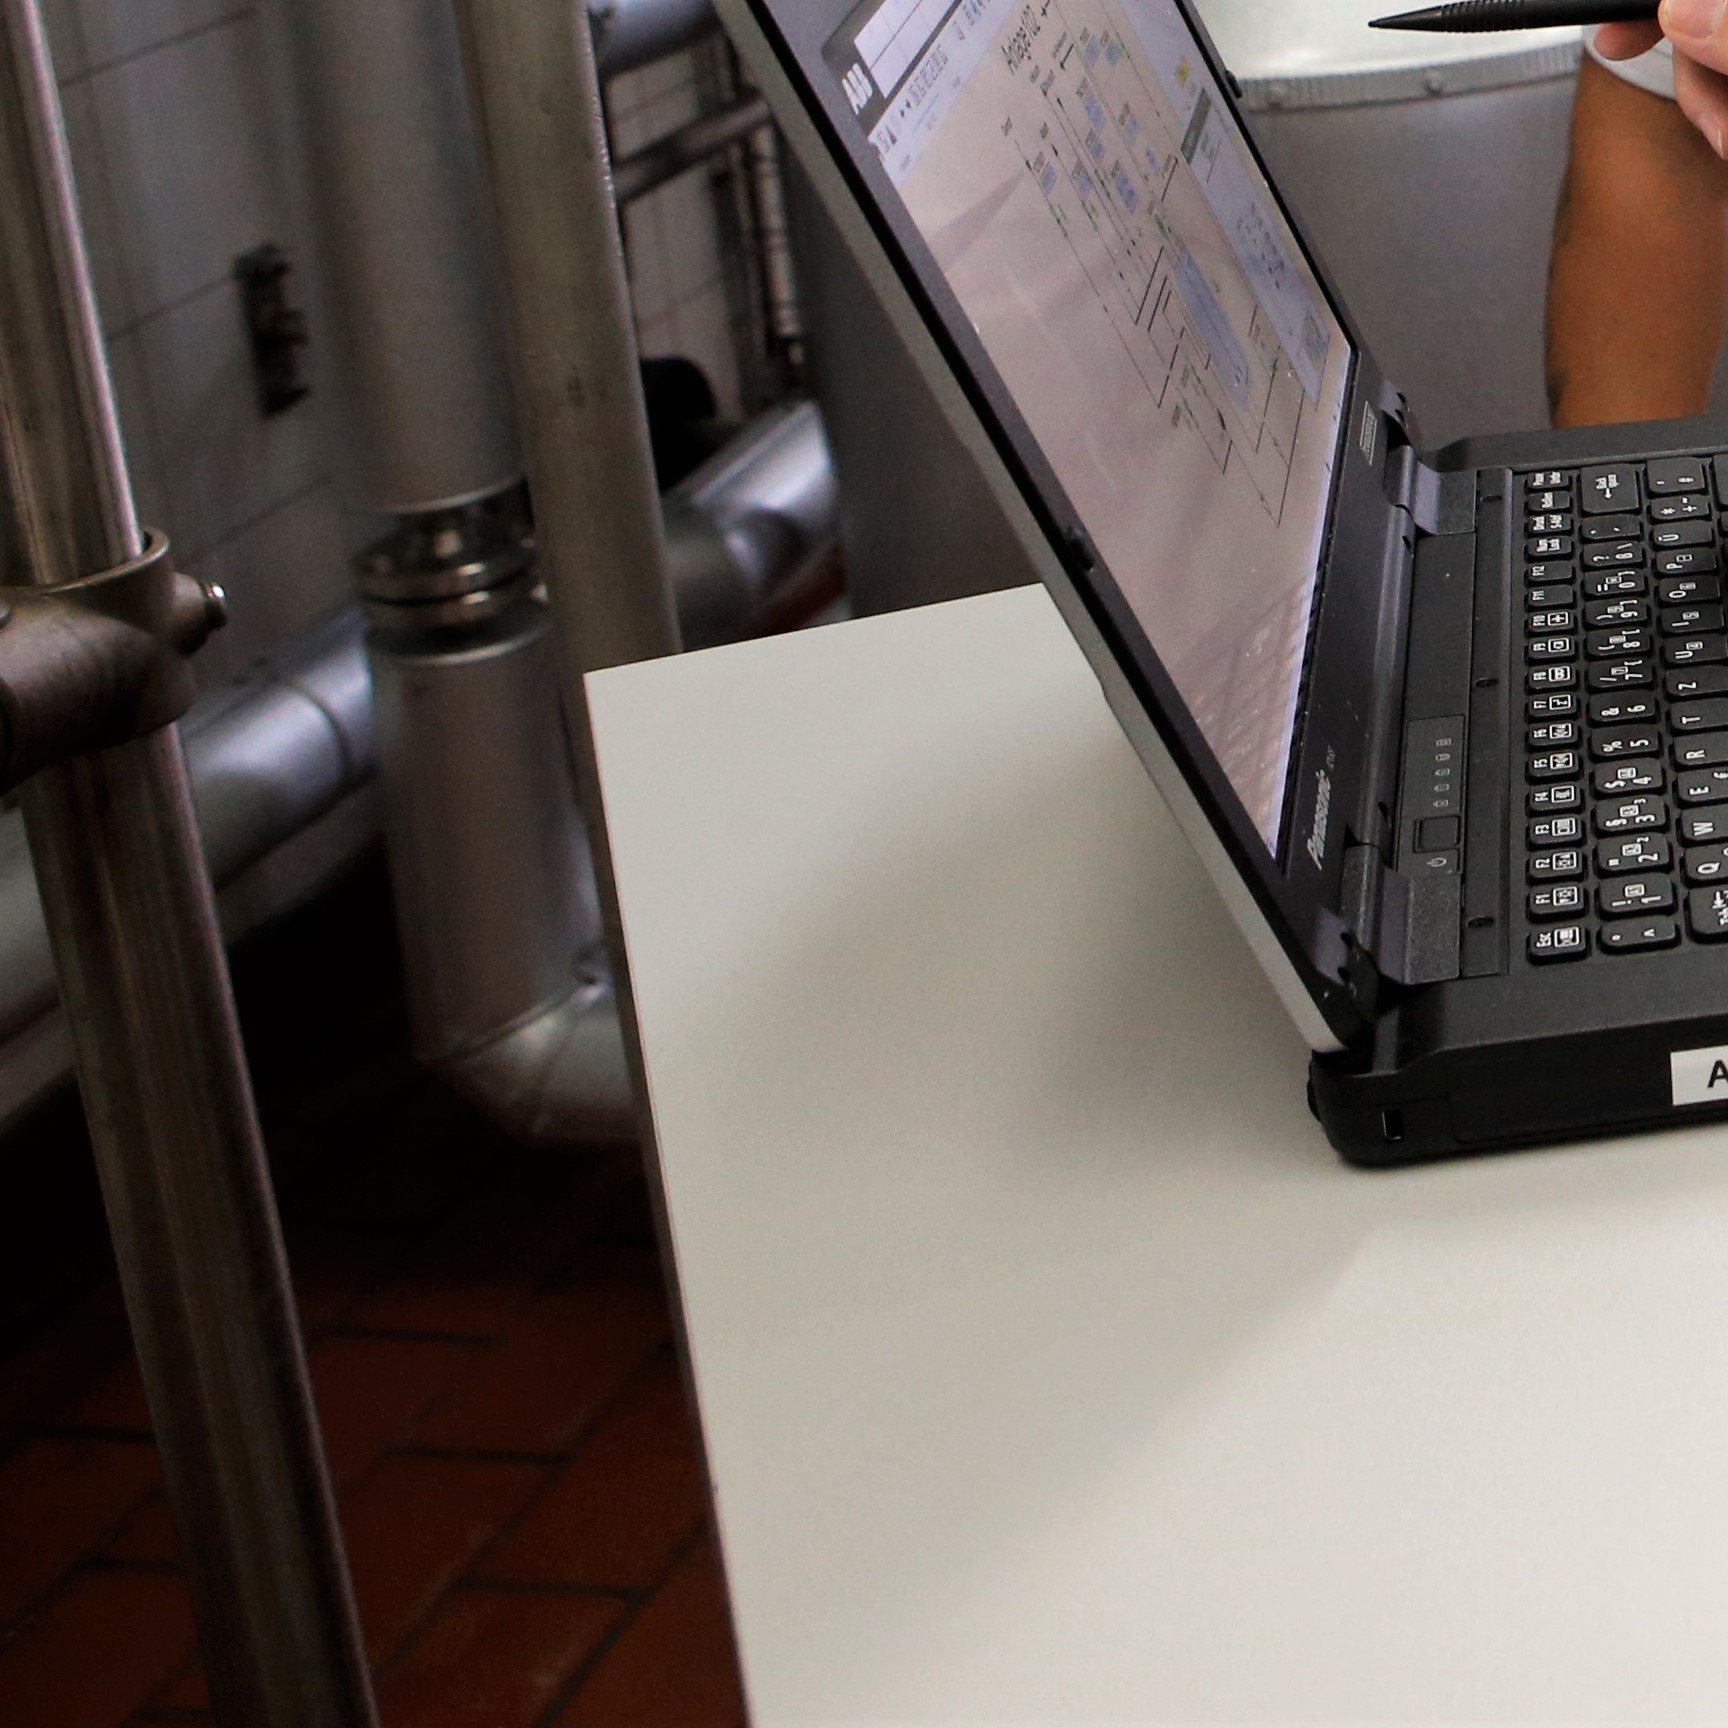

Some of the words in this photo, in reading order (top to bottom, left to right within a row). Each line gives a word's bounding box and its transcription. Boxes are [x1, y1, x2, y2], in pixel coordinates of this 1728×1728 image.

[842, 63, 873, 115] ABB
[1533, 566, 1544, 576] F12
[1533, 591, 1544, 600] F11
[1533, 643, 1545, 651] F9
[1534, 672, 1546, 680] F8
[1534, 729, 1546, 737] F6
[1603, 741, 1622, 752] %
[1686, 750, 1704, 759] R
[1534, 759, 1547, 768] F5
[1535, 792, 1548, 801] F4
[1636, 815, 1654, 823] 3
[1536, 825, 1549, 834] F3
[1693, 823, 1713, 835] W
[1638, 854, 1658, 862] 2
[1536, 859, 1550, 868] F2
[1698, 863, 1719, 873] Q
[1536, 895, 1550, 904] F1
